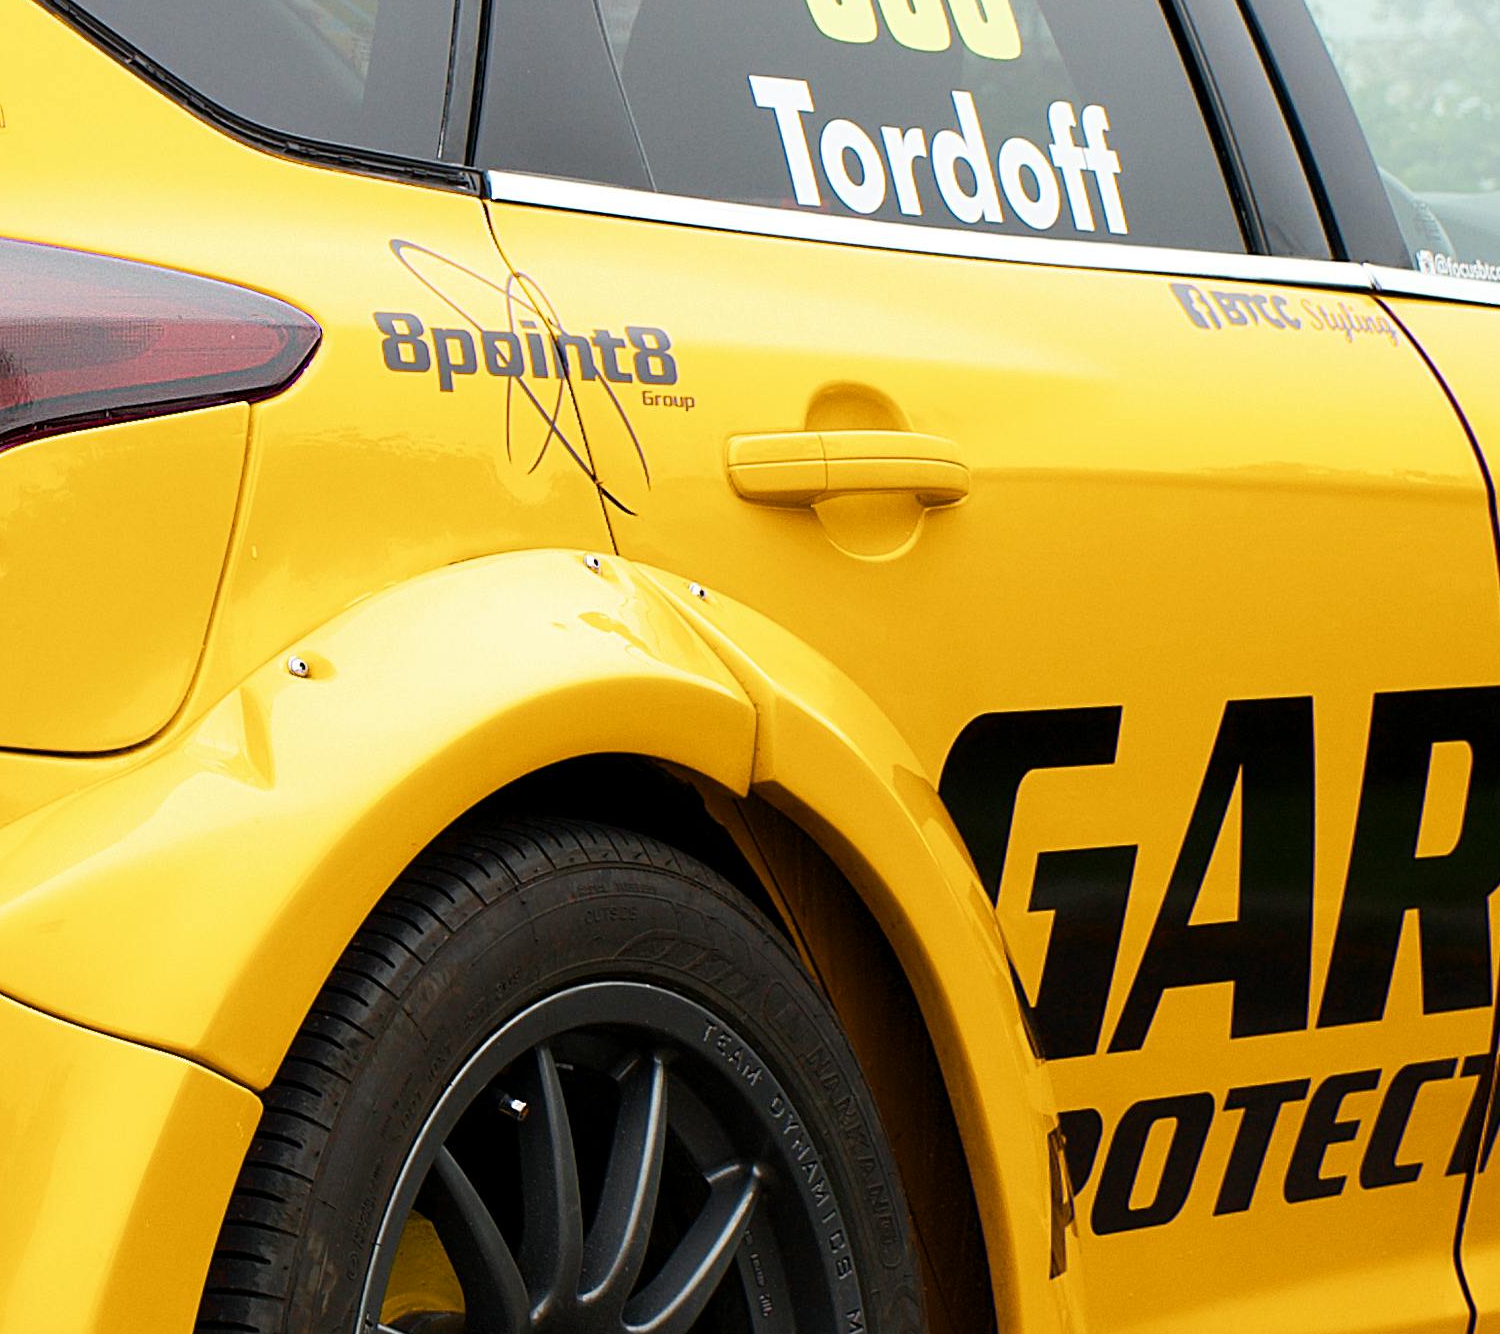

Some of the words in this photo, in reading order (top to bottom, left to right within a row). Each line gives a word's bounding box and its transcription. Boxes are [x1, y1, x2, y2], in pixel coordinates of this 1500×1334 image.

[747, 74, 1129, 235] Tordoff
[372, 310, 680, 394] 8point8
[1209, 289, 1302, 331] BTCC
[1300, 298, 1400, 348] Styling
[641, 389, 697, 413] Group
[701, 1017, 765, 1087] TEAM
[768, 1092, 852, 1281] DYNAMICS
